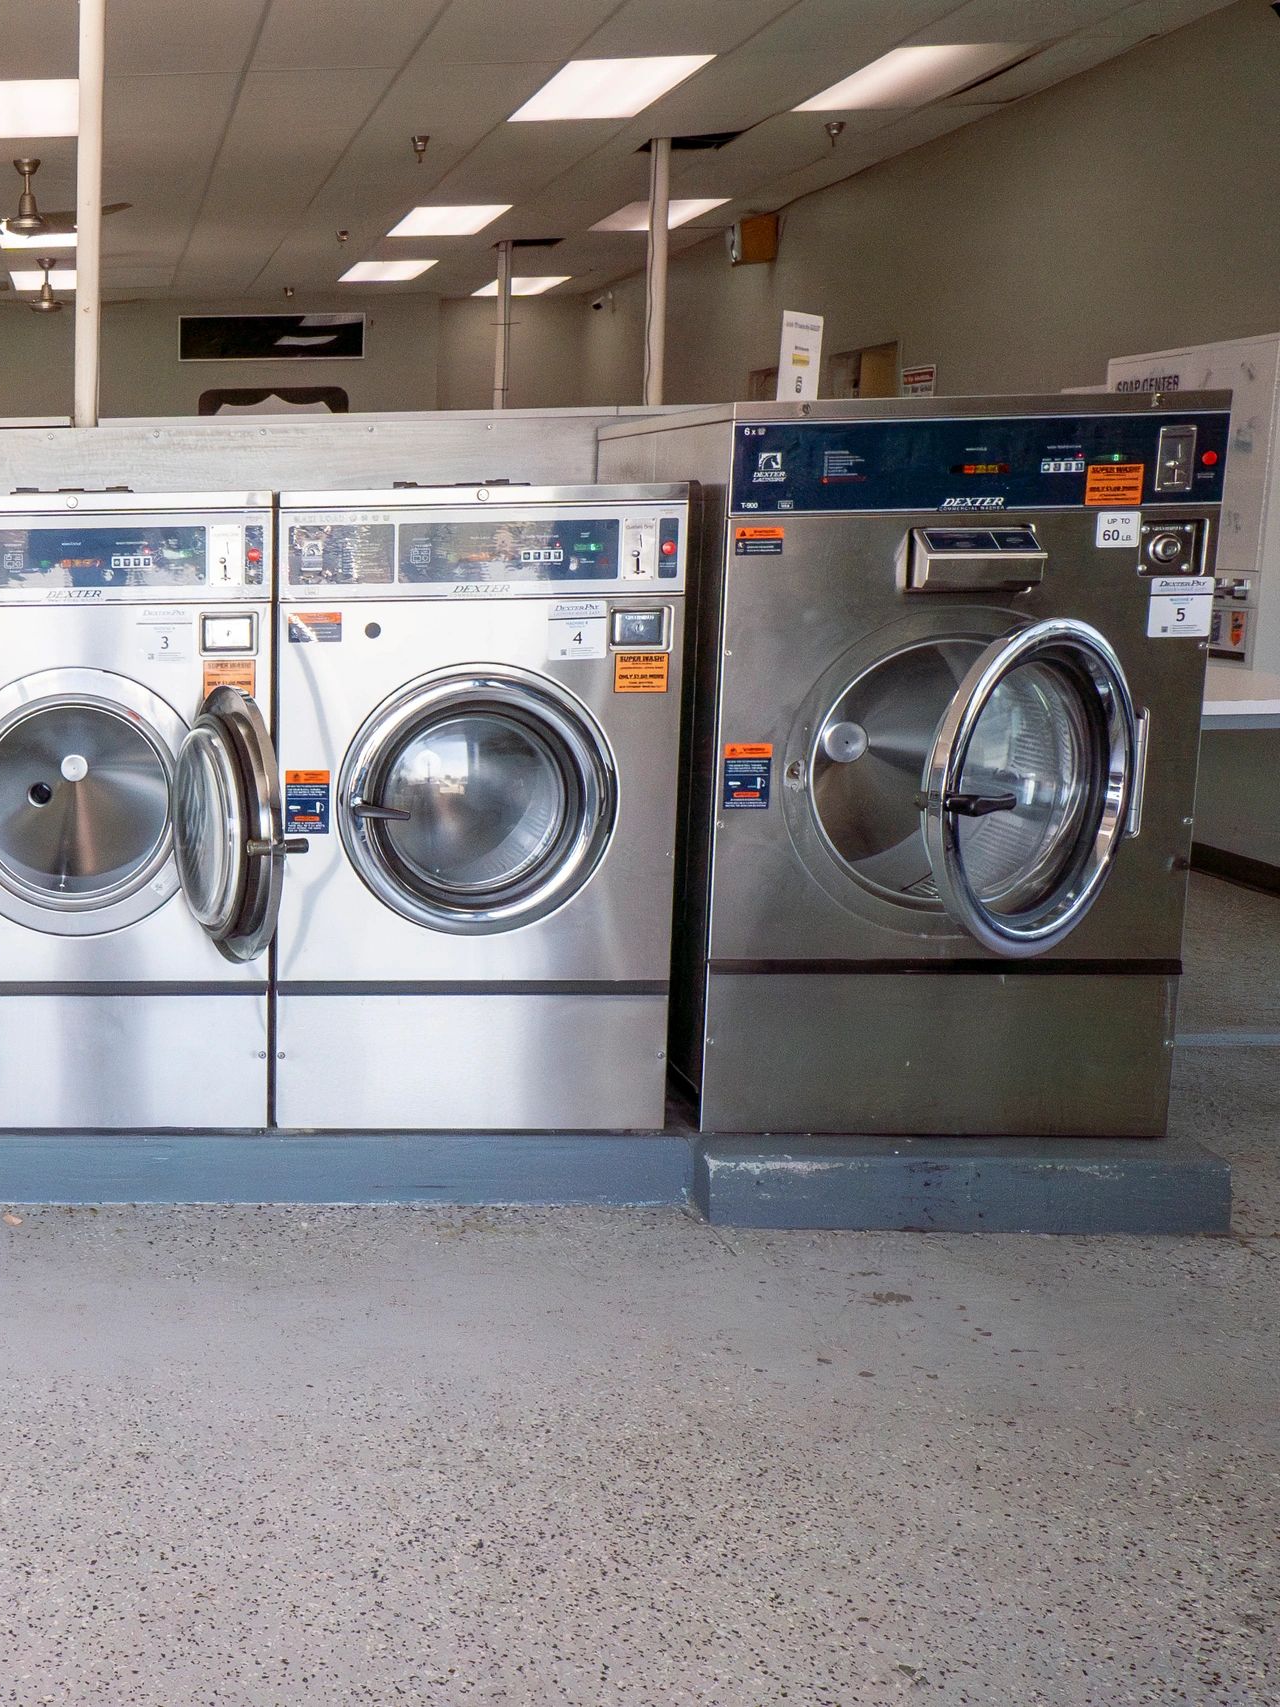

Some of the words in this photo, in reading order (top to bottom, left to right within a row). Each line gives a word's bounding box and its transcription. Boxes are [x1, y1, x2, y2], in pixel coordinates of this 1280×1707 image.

[1117, 379, 1141, 392] SOAP
[1142, 375, 1180, 391] CENTER
[744, 427, 751, 436] 6
[941, 497, 1004, 507] DEXTER
[1102, 529, 1120, 541] 60
[46, 589, 102, 598] DEXTER
[452, 584, 510, 593] DEXTER
[1176, 607, 1186, 622] 5
[160, 635, 169, 650] 3
[572, 631, 583, 645] 4
